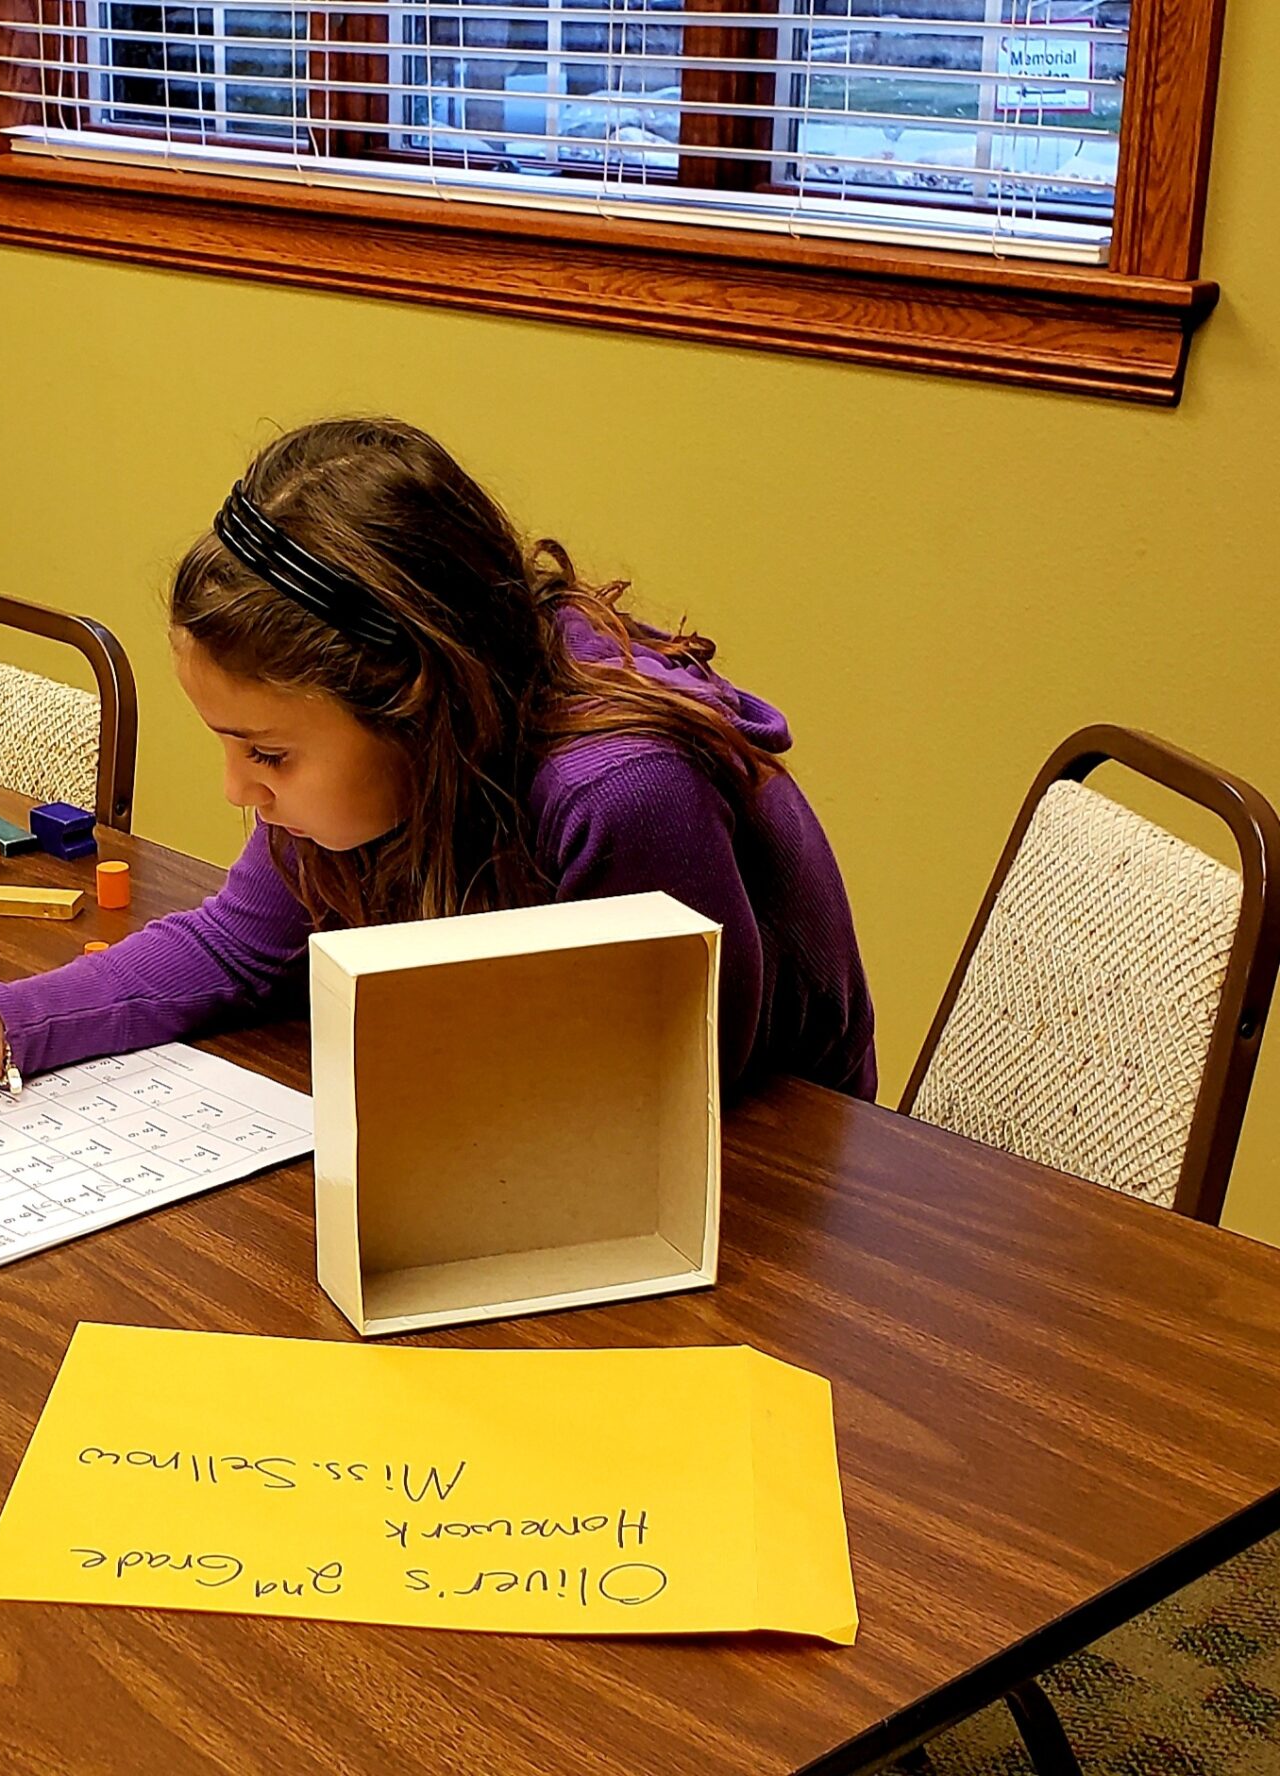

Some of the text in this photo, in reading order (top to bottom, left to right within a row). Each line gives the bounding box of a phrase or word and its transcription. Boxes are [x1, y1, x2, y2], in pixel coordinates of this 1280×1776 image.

[1011, 50, 1077, 65] Memorial
[79, 1448, 295, 1488] Sellnow
[386, 1510, 648, 1546] Homework
[71, 1550, 667, 1605] Oliver's 2nd Grade
